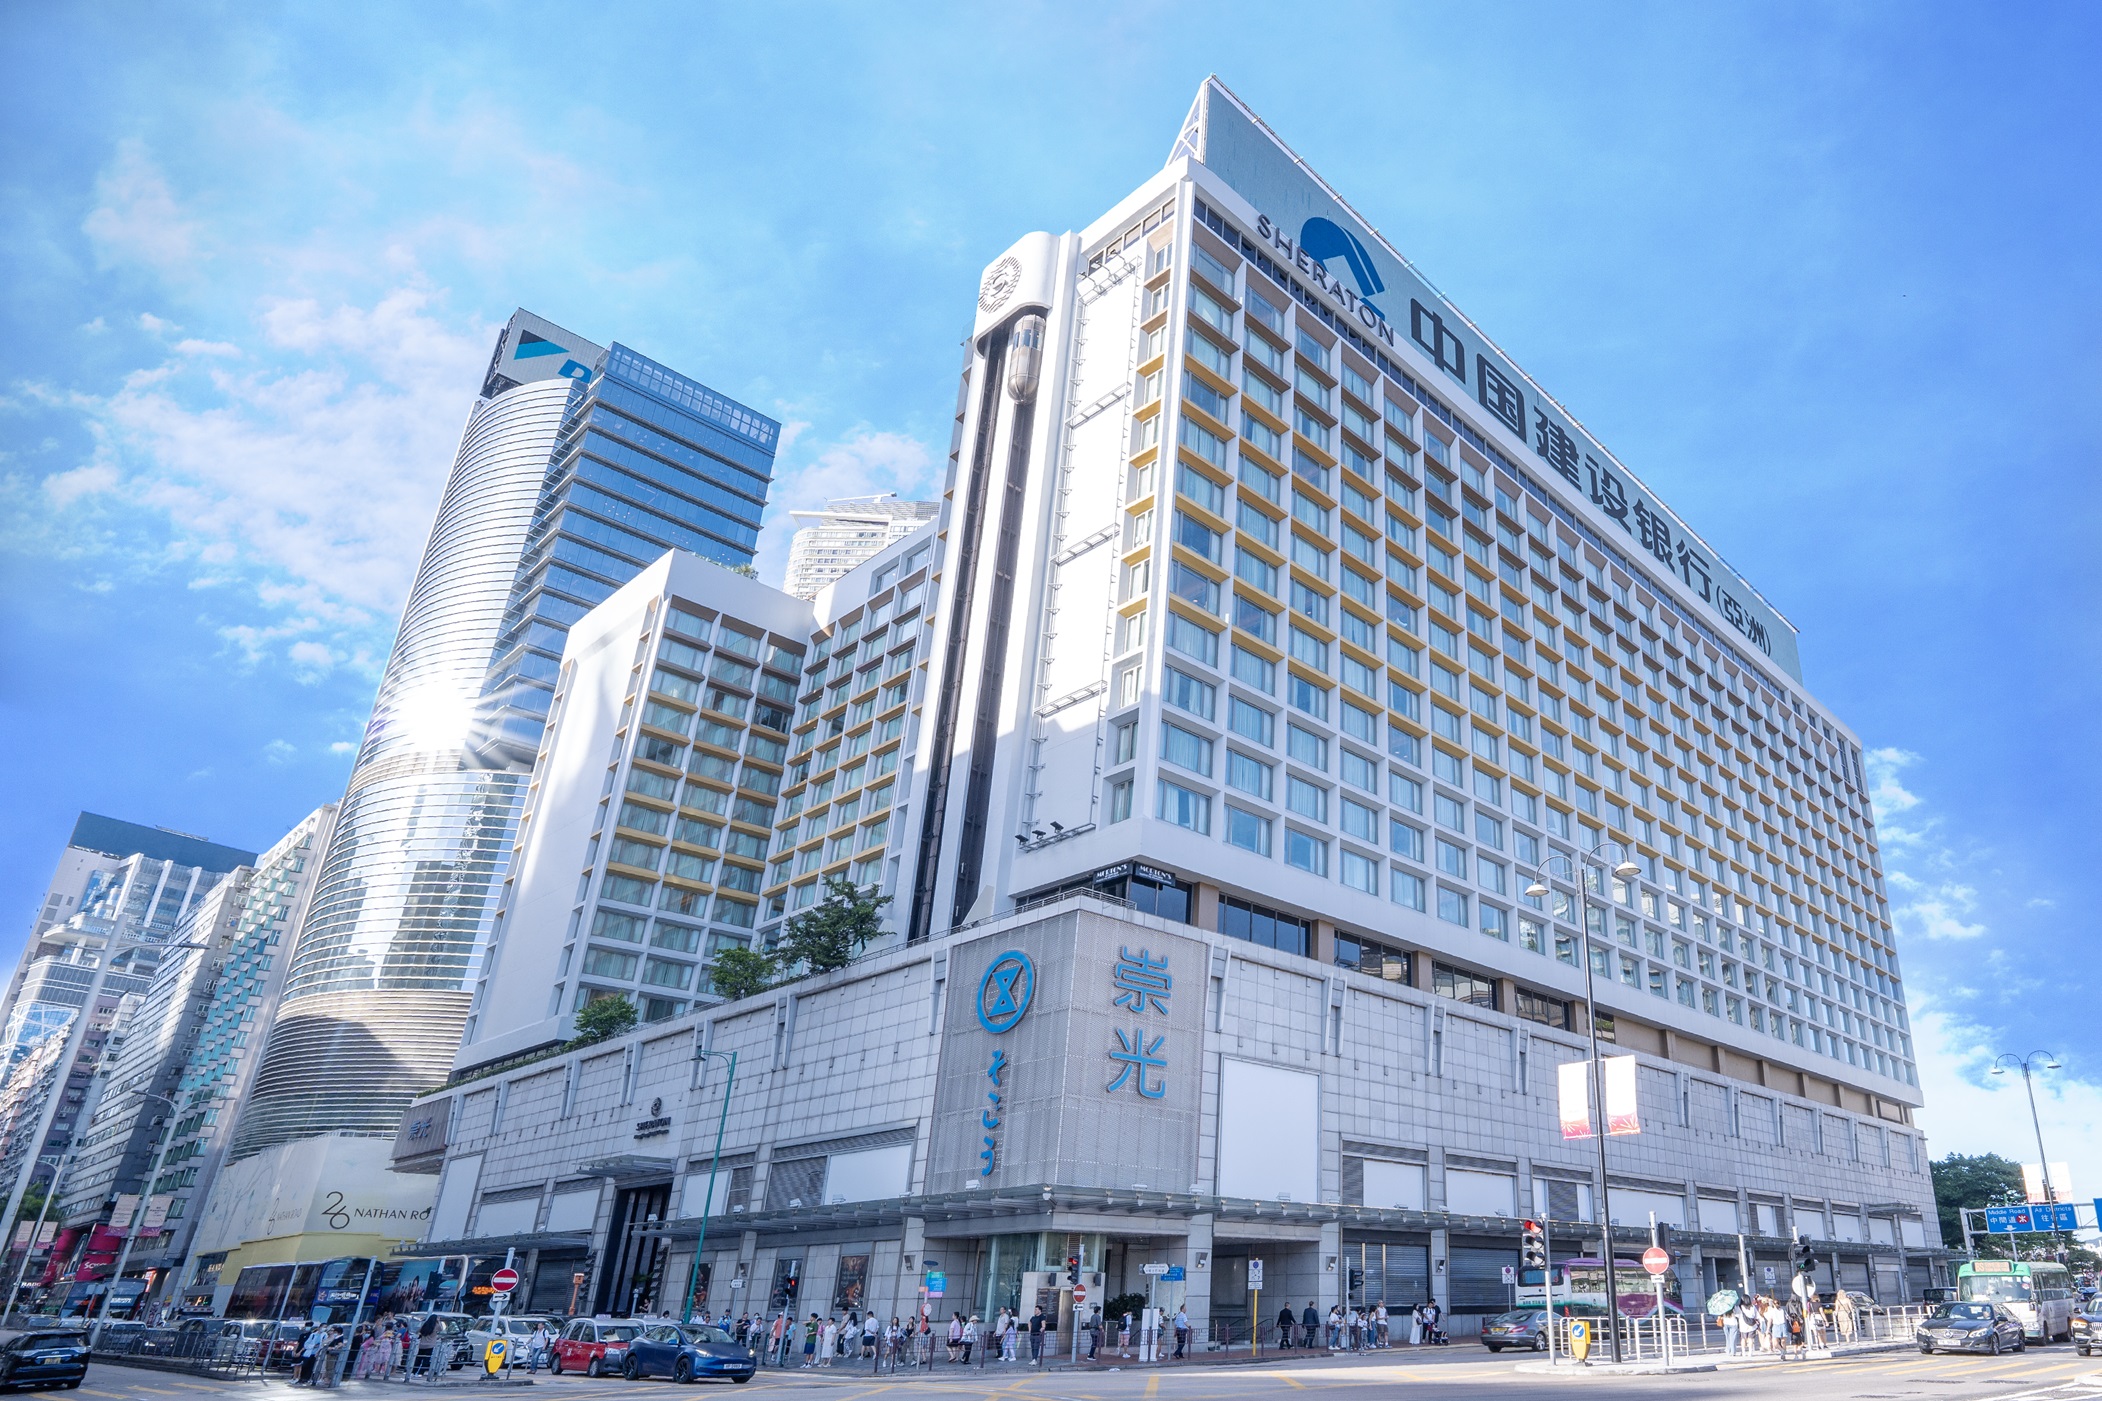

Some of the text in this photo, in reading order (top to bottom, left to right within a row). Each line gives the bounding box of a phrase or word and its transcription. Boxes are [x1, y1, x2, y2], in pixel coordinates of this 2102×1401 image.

[1257, 214, 1394, 347] SHERATON
[1107, 945, 1172, 1099] 崇光
[981, 1050, 1007, 1177] そごう
[321, 1191, 350, 1229] 26
[354, 1208, 408, 1220] NATHAN
